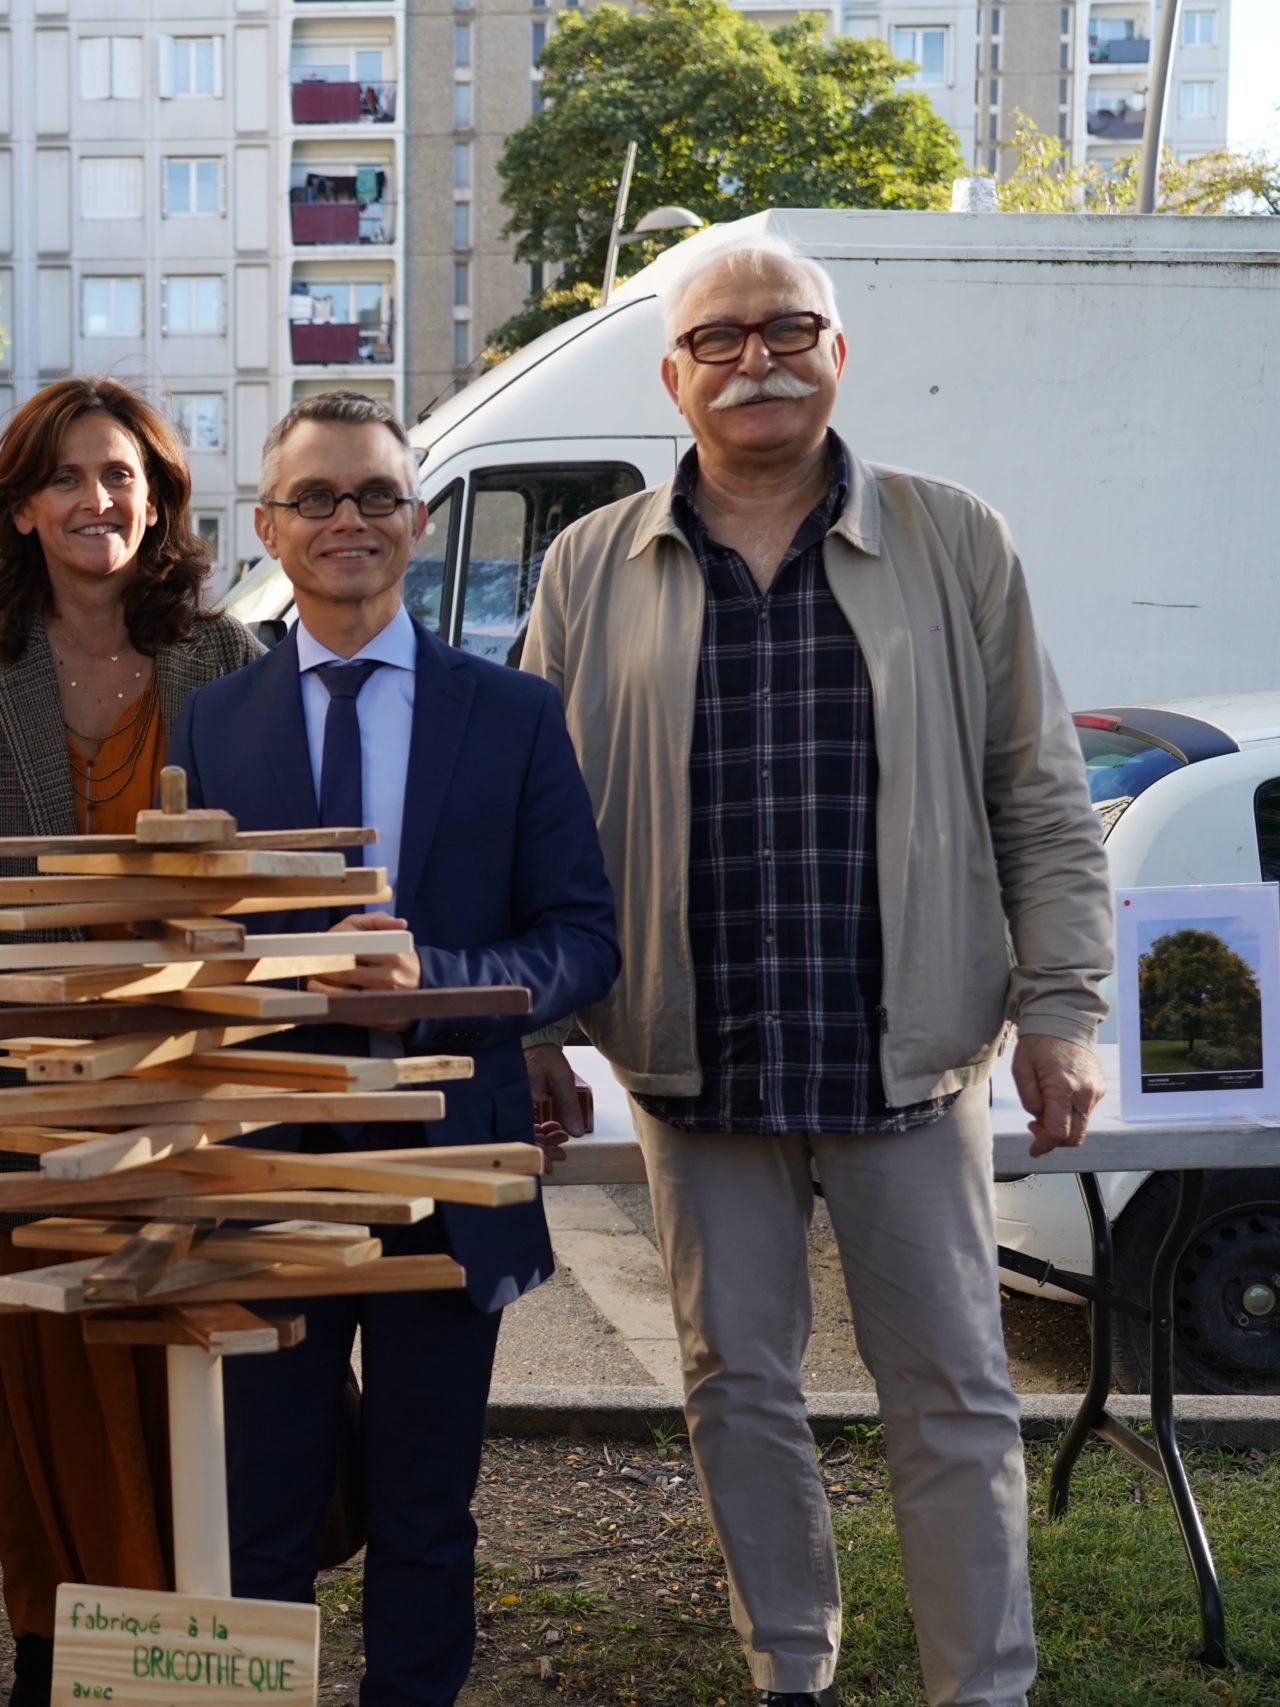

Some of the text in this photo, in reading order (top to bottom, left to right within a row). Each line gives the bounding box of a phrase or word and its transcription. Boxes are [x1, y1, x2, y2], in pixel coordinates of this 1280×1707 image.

[69, 1602, 229, 1640] fabriqué à la
[132, 1645, 295, 1693] BRICOTHÈQUE
[72, 1681, 114, 1700] avec
